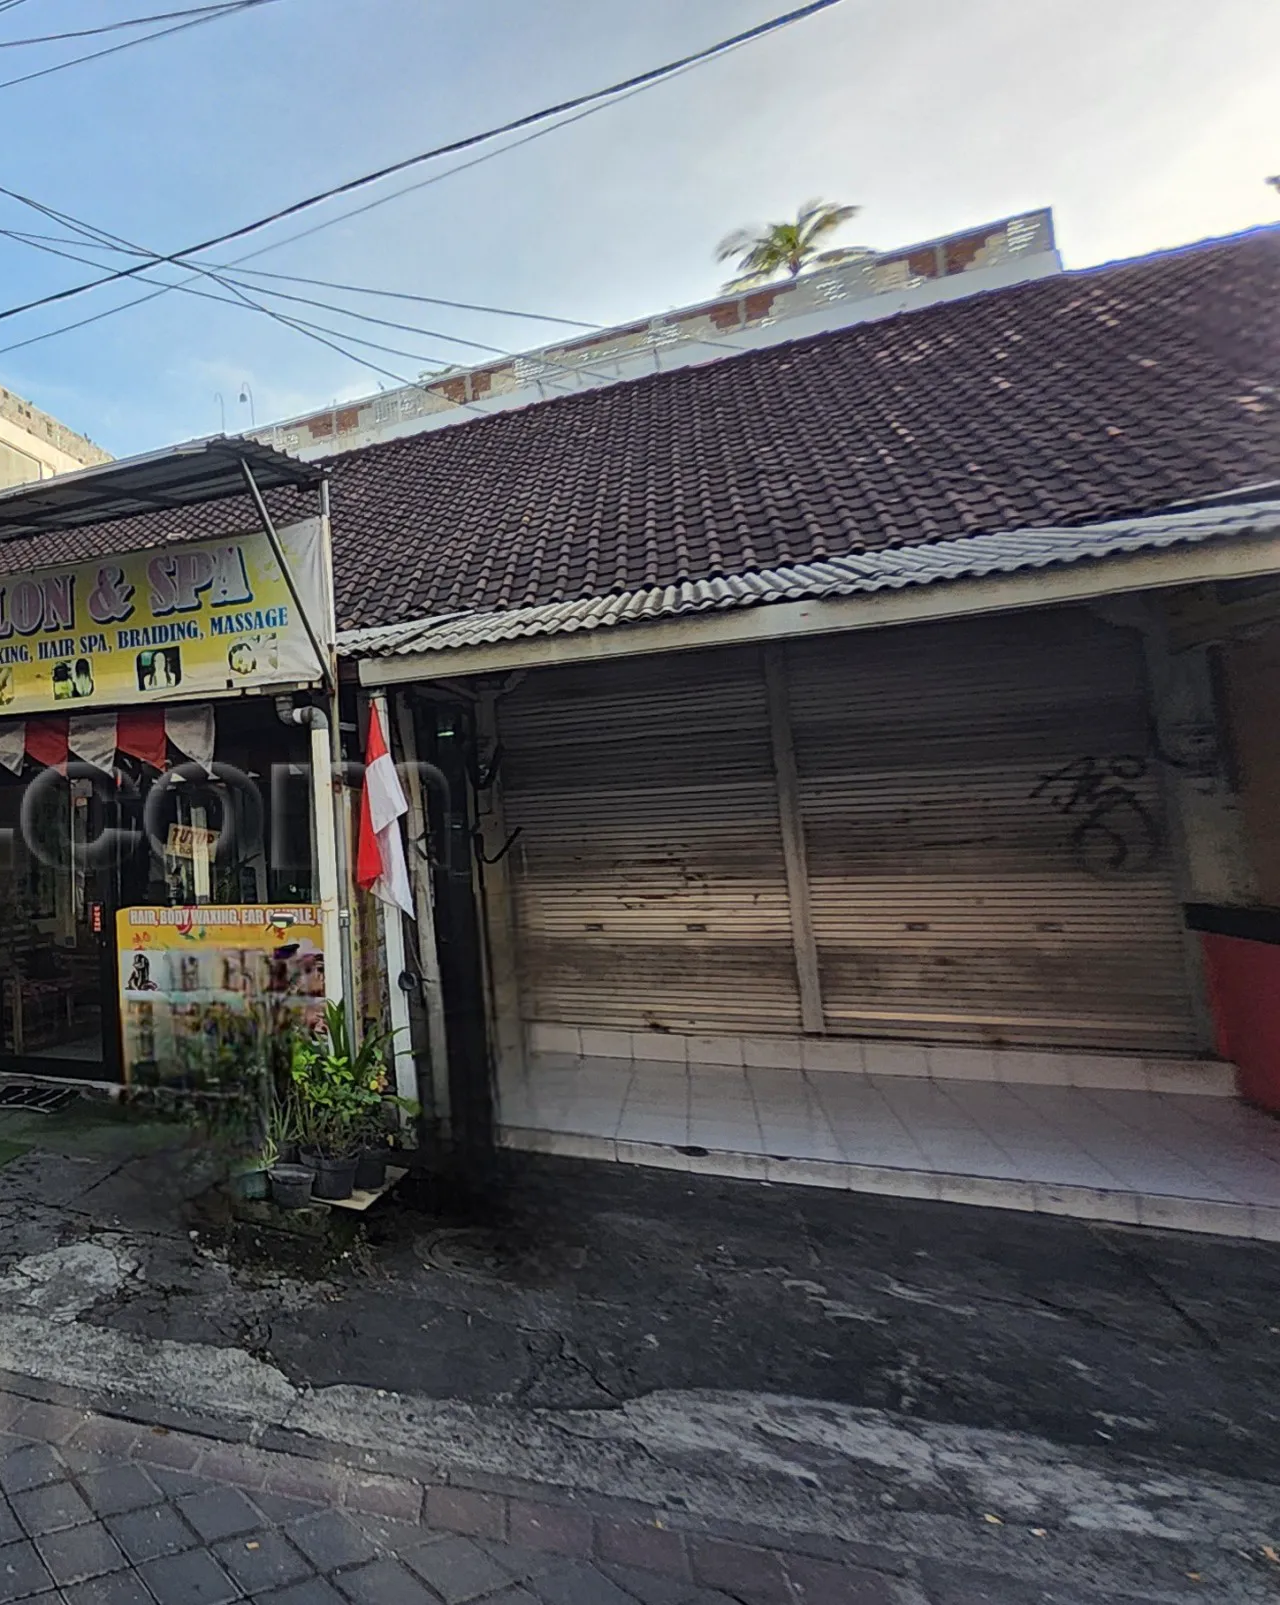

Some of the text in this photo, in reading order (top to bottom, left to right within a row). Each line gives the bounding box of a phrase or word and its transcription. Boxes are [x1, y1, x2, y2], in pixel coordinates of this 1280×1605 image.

[88, 563, 136, 625] &
[148, 546, 254, 617] SPA
[38, 638, 75, 660] HAIR
[80, 632, 113, 654] SPA,
[117, 620, 205, 649] BRAIDING,
[210, 606, 289, 637] MASSAGE
[159, 908, 190, 925] BODY
[242, 909, 264, 925] EAR
